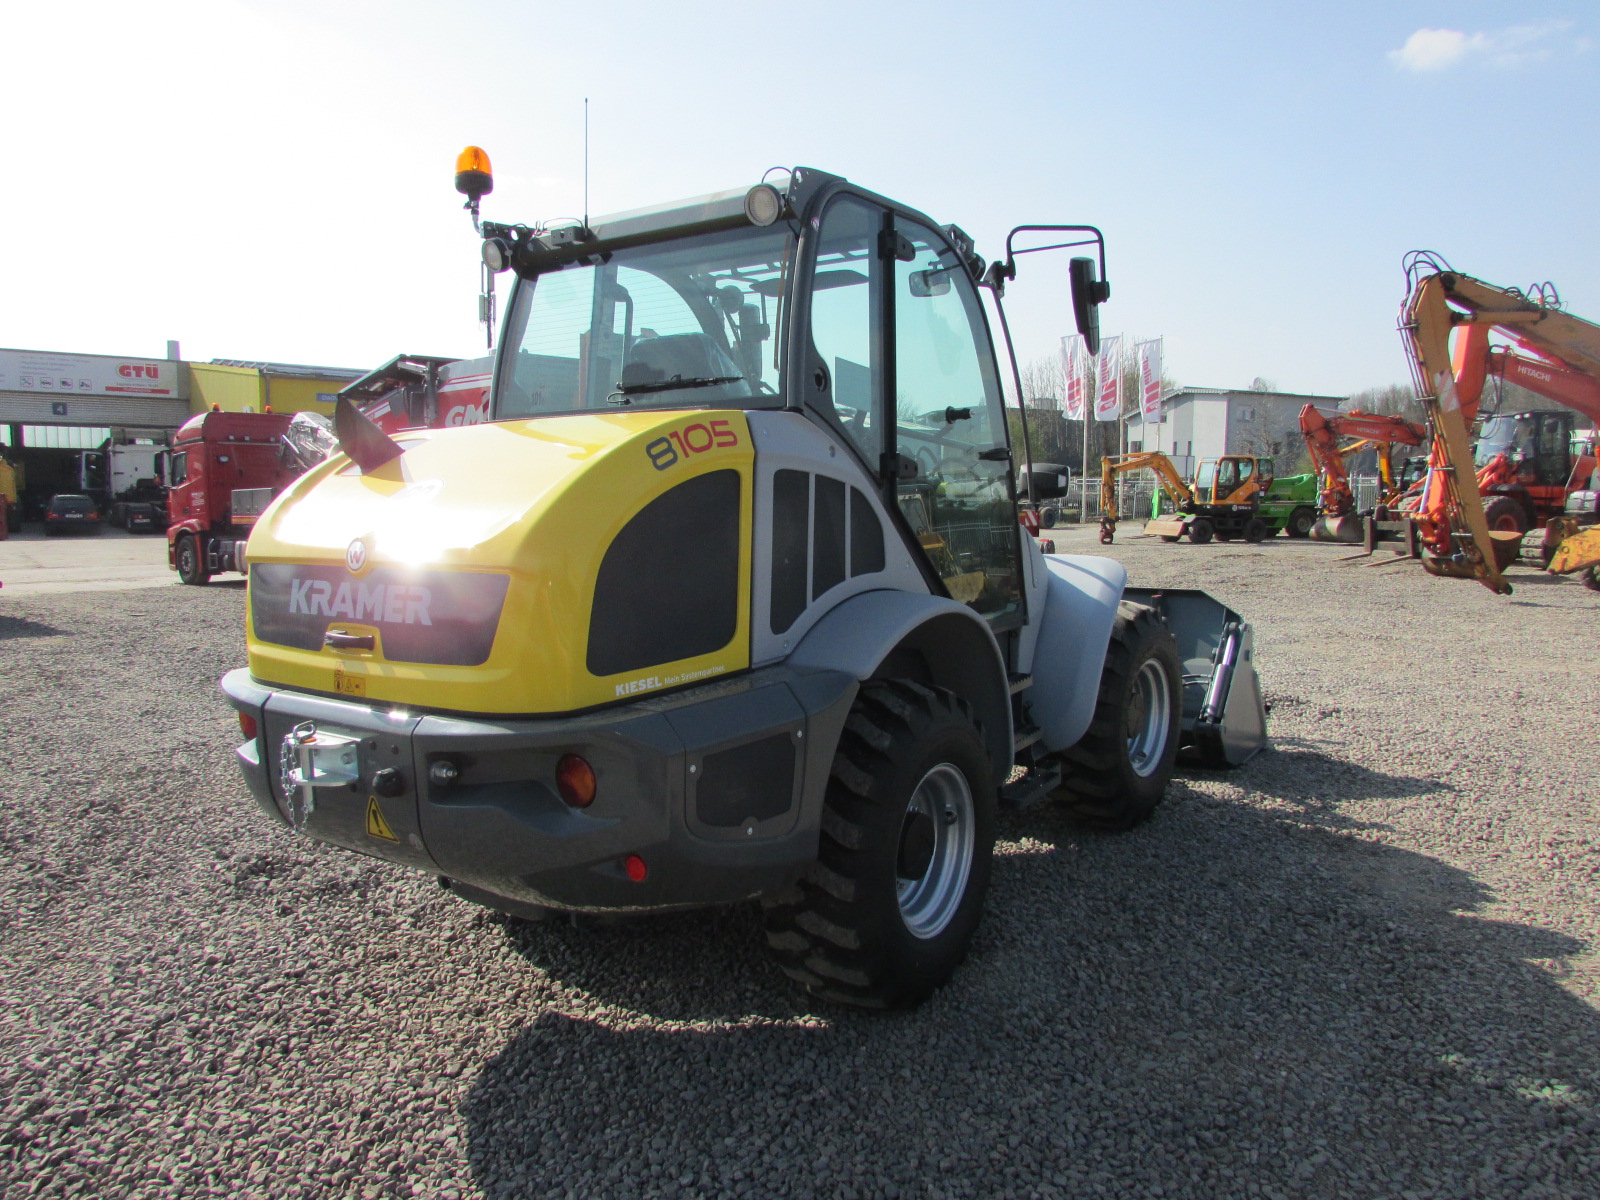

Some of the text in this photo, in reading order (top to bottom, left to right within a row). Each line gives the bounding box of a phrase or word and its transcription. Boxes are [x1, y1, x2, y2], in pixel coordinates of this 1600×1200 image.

[118, 363, 159, 379] GTÜ
[1517, 365, 1551, 382] HITACHI
[645, 420, 738, 471] 8105
[289, 578, 432, 626] KRAMER
[615, 676, 663, 697] KIESEL
[664, 675, 680, 685] Mein
